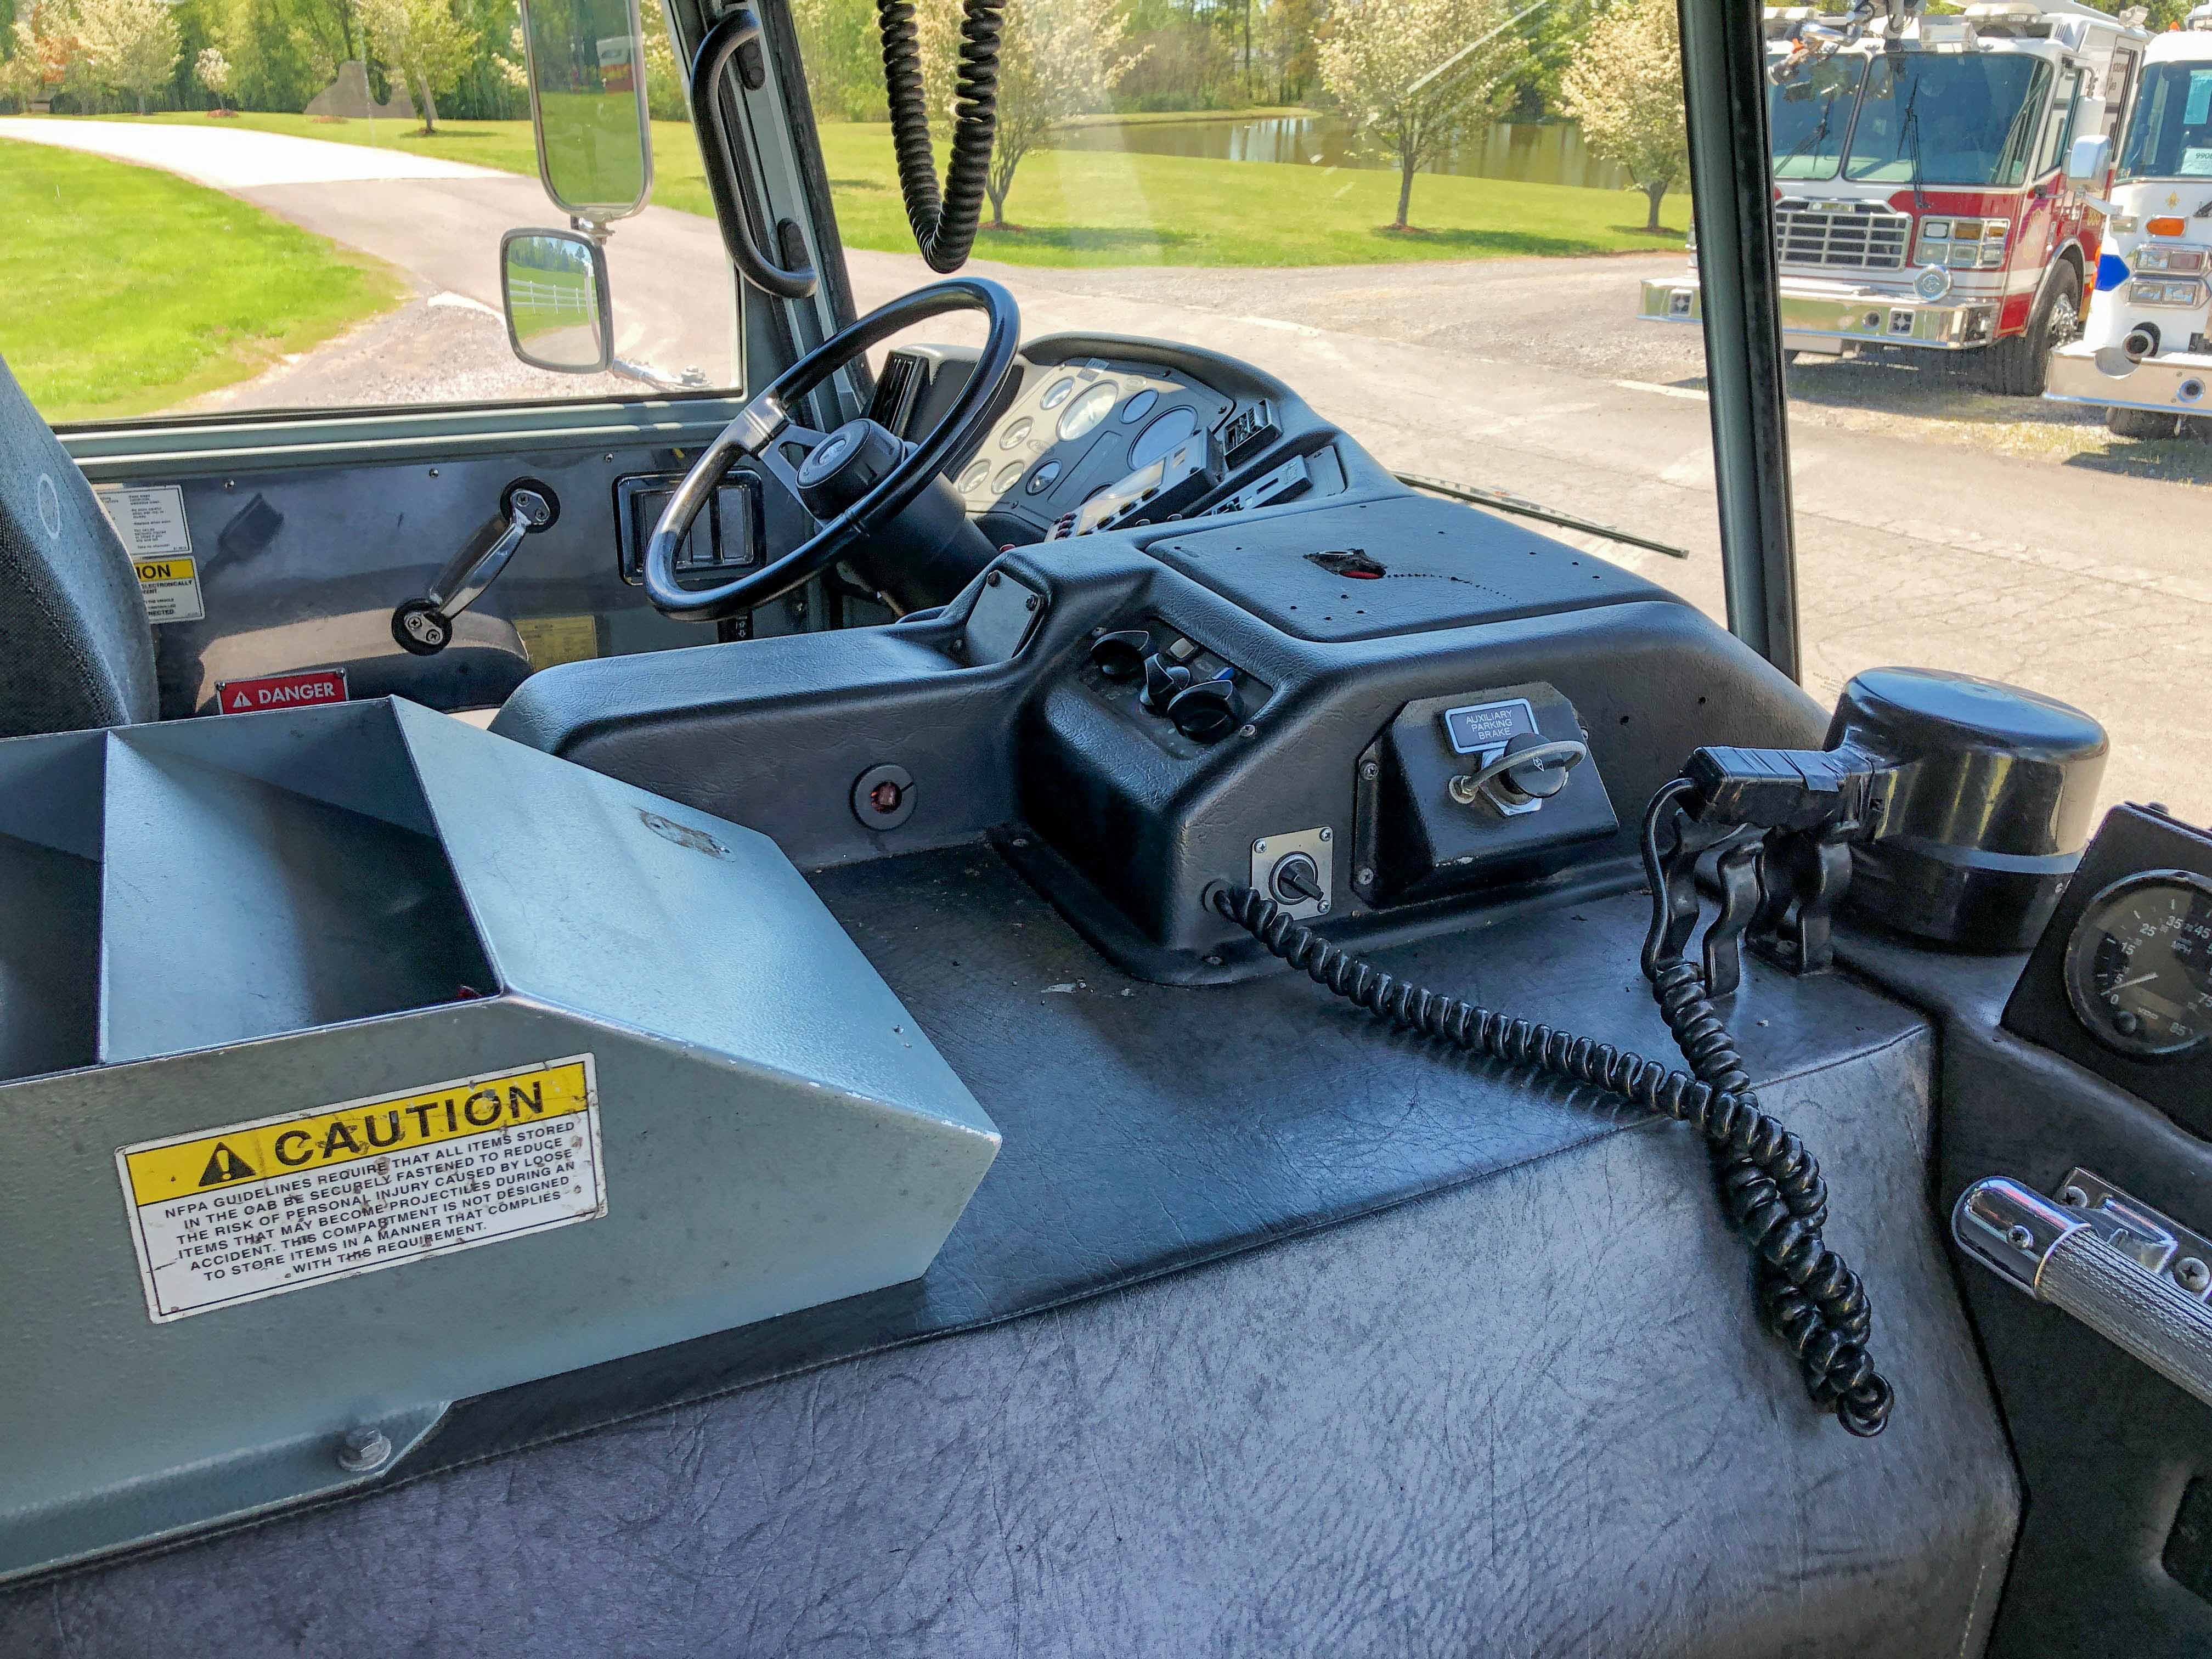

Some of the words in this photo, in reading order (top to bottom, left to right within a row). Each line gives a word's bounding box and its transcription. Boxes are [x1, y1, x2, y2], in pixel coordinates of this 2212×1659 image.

[258, 682, 336, 704] DANGER
[1466, 709, 1512, 724] AUXILIARY
[1471, 719, 1513, 732] PARKING
[1479, 728, 1511, 740] BRAKE
[2140, 923, 2157, 936] 25
[2166, 915, 2183, 929] 35
[2194, 926, 2211, 939] 45
[2121, 942, 2136, 955] 15
[2114, 974, 2124, 984] 5
[2110, 994, 2119, 1005] 0
[274, 1080, 544, 1166] CAUTION
[165, 1201, 208, 1218] NFPA
[214, 1178, 312, 1207] GUIDELINES
[318, 1162, 387, 1185] REQUIRE
[392, 1153, 430, 1168] THAT
[436, 1146, 463, 1159] ALL
[468, 1135, 512, 1152] ITEMS
[517, 1122, 574, 1142] STORED
[184, 1217, 200, 1229] IN
[206, 1209, 238, 1223] THE
[244, 1200, 277, 1215] CAB
[284, 1194, 303, 1206] BE
[310, 1175, 392, 1200] SECURELY
[397, 1158, 475, 1181] FASTENED
[479, 1152, 499, 1163] TO
[504, 1137, 563, 1158] REDUCE
[177, 1230, 208, 1244] THE
[215, 1220, 253, 1236] RISK
[259, 1214, 280, 1226] OF
[286, 1194, 371, 1220] PERSONAL
[376, 1180, 429, 1200] INJURY
[435, 1166, 495, 1187] CAUSED
[501, 1160, 519, 1172] BY
[525, 1149, 572, 1167] LOOSE
[178, 1240, 228, 1259] ITEMS
[234, 1229, 274, 1246] THAT
[281, 1220, 312, 1235] MAY
[319, 1204, 383, 1227] BECOME
[390, 1181, 491, 1210] PROJECTILES
[496, 1167, 551, 1187] DURING
[556, 1161, 575, 1173] AN
[190, 1244, 276, 1271] ACCIDENT.
[280, 1234, 317, 1249] THIS
[323, 1206, 438, 1239] COMPARTMENT
[444, 1201, 456, 1212] IS
[462, 1194, 491, 1207] NOT
[497, 1176, 569, 1200] DESIGNED
[204, 1269, 225, 1281] TO
[232, 1255, 285, 1275] STORE
[291, 1242, 337, 1261] ITEMS
[343, 1238, 357, 1249] IN
[364, 1235, 373, 1244] A
[378, 1218, 441, 1240] MANNER
[447, 1209, 482, 1224] THAT
[489, 1191, 561, 1215] COMPLIES
[293, 1257, 332, 1273] WITH
[337, 1248, 371, 1263] THIS
[377, 1222, 487, 1254] REQUIREMENT.
